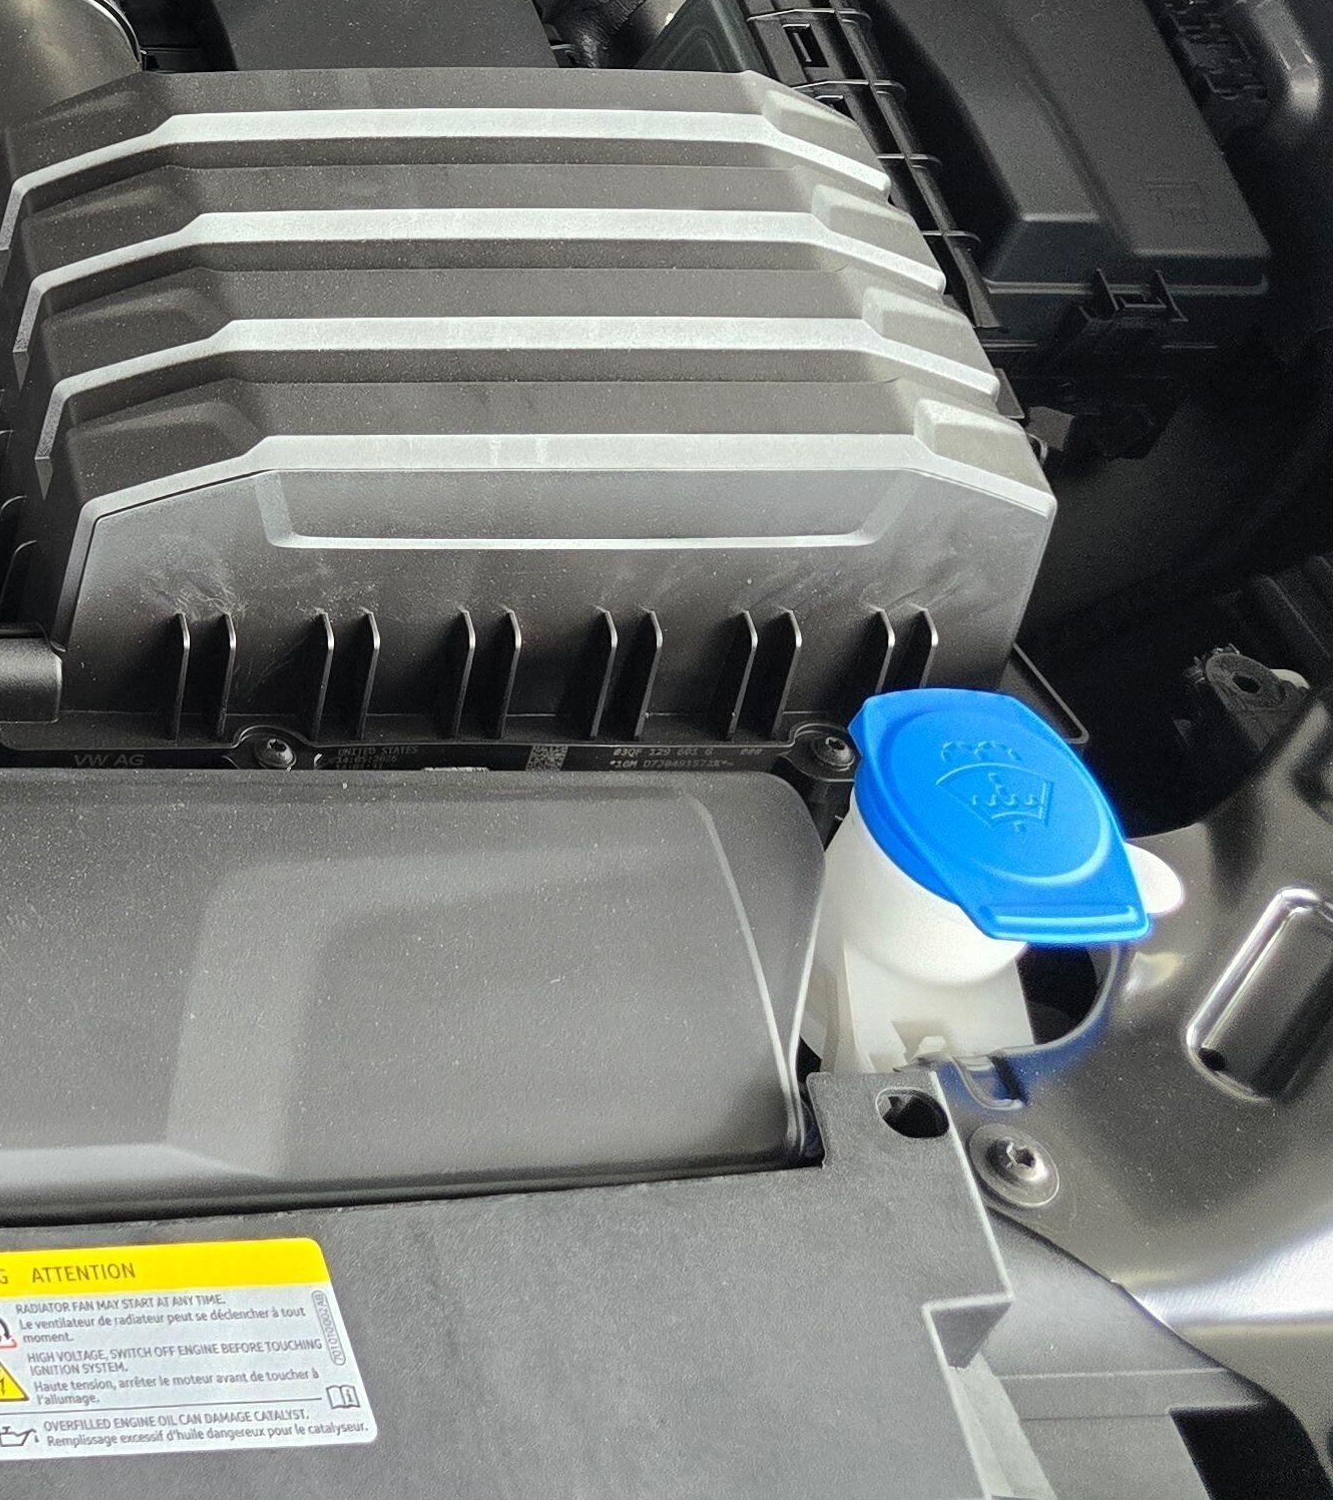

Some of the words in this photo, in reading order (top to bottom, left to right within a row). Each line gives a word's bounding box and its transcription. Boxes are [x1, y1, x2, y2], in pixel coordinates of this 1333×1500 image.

[74, 754, 109, 767] VW
[114, 754, 145, 766] AG
[32, 1262, 136, 1284] ATTENTION
[16, 1302, 70, 1314] RADIATOR
[73, 1302, 94, 1312] FAN
[96, 1299, 120, 1309] MAY
[122, 1297, 154, 1309] START
[157, 1296, 169, 1306] AT
[173, 1296, 193, 1306] ANY
[20, 1319, 33, 1330] Le
[35, 1318, 94, 1329] ventilateur
[98, 1316, 112, 1326] de
[114, 1313, 164, 1325] radiateur
[167, 1312, 192, 1325] peut
[210, 1307, 269, 1320] déclencher
[281, 1307, 305, 1317] tout
[23, 1332, 74, 1343] moment.
[27, 1352, 53, 1363] HIGH
[110, 1348, 152, 1359] SWITCH
[154, 1346, 174, 1357] OFF
[178, 1343, 220, 1356] ENGINE
[222, 1341, 264, 1353] BEFORE
[265, 1339, 322, 1352] TOUCHING
[30, 1364, 80, 1376] IGNITION
[83, 1362, 128, 1373] SYSTEM.
[35, 1381, 68, 1392] Haute
[71, 1379, 116, 1391] tension,
[172, 1374, 213, 1386] moteur
[216, 1372, 247, 1383] avant
[250, 1371, 263, 1382] de
[266, 1369, 308, 1381] toucher
[44, 1420, 111, 1432] OVERFILLED
[114, 1417, 155, 1429] ENGINE
[157, 1415, 176, 1426] OIL
[179, 1413, 202, 1425] CAN
[205, 1411, 252, 1423] DAMAGE
[254, 1409, 309, 1422] CATALYST.
[47, 1435, 116, 1448] Remplissage
[120, 1431, 163, 1443] excessif
[206, 1427, 264, 1442] dangereux
[268, 1426, 292, 1438] pour
[308, 1422, 369, 1435] catalyseur.
